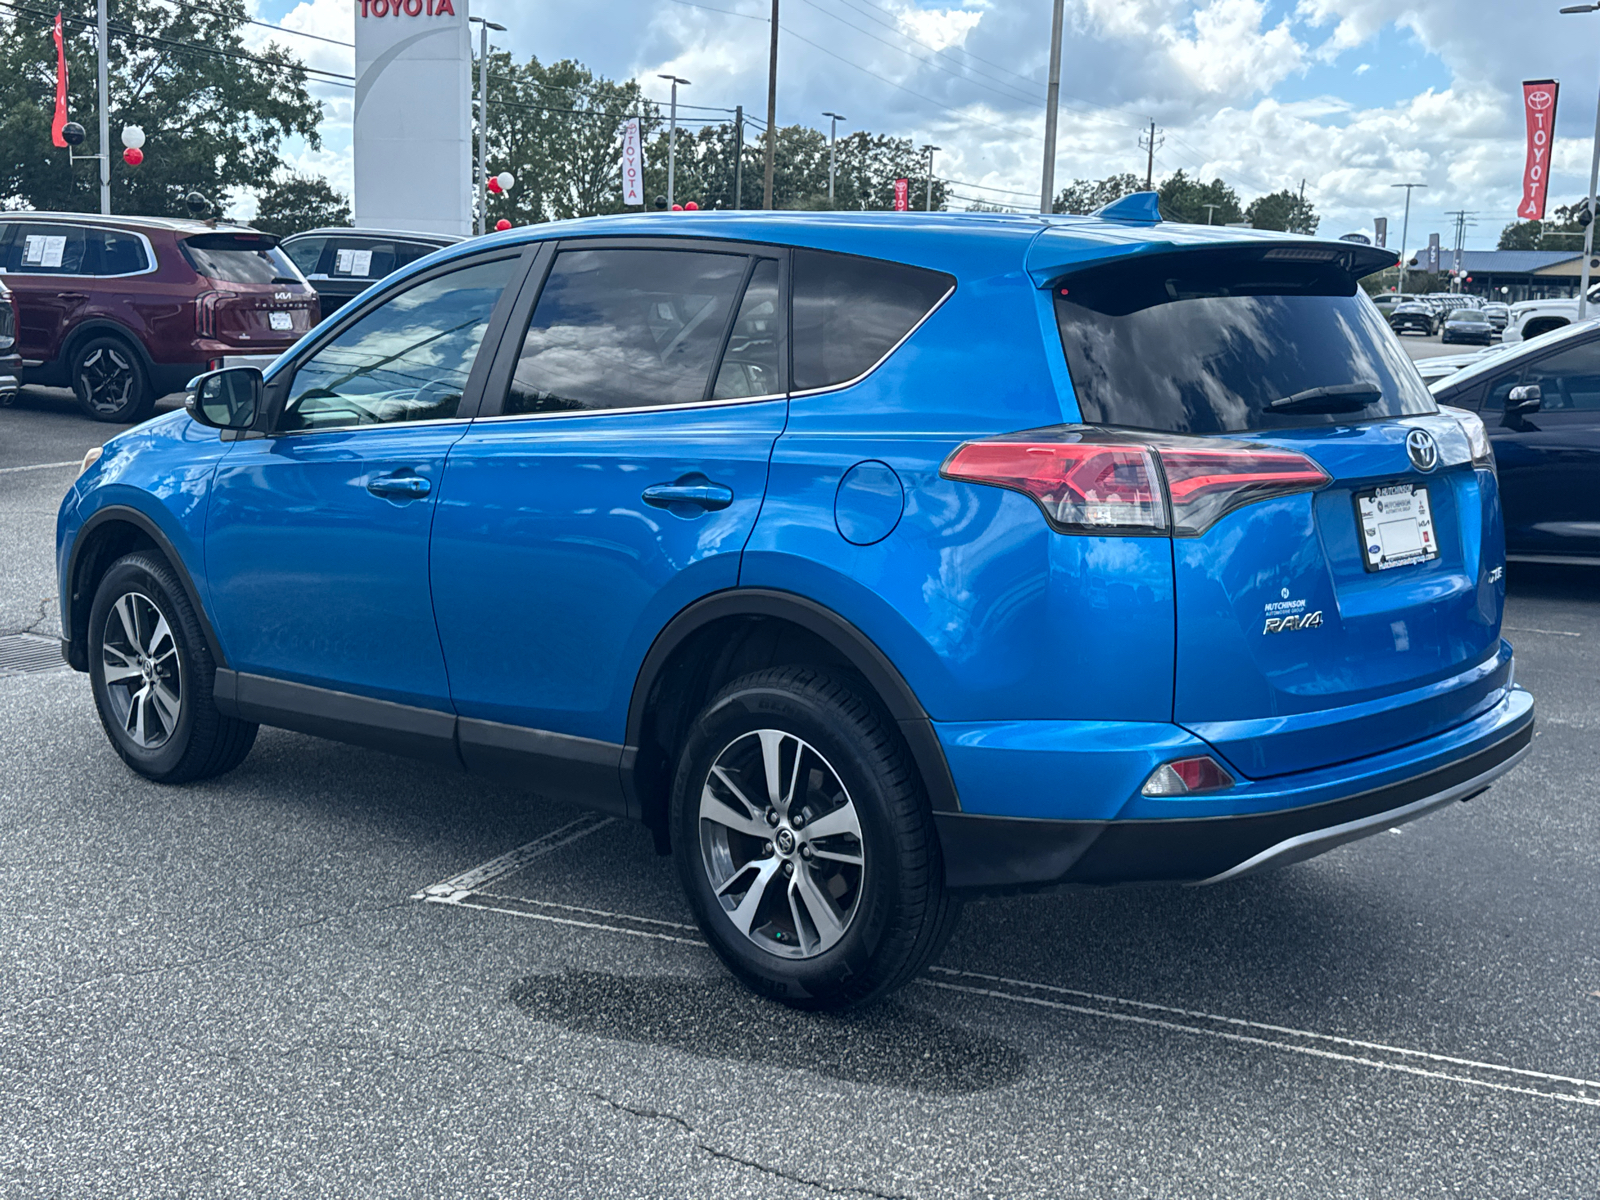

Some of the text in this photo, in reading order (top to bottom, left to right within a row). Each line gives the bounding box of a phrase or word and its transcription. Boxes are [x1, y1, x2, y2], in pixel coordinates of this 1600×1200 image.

[358, 0, 455, 18] TOYOTA
[625, 136, 637, 198] TOYOTA
[1525, 113, 1547, 215] TOYOTA
[1381, 484, 1413, 497] HUTCHINSON
[1264, 599, 1306, 611] HUTCHINSON
[1263, 611, 1323, 635] RAV4
